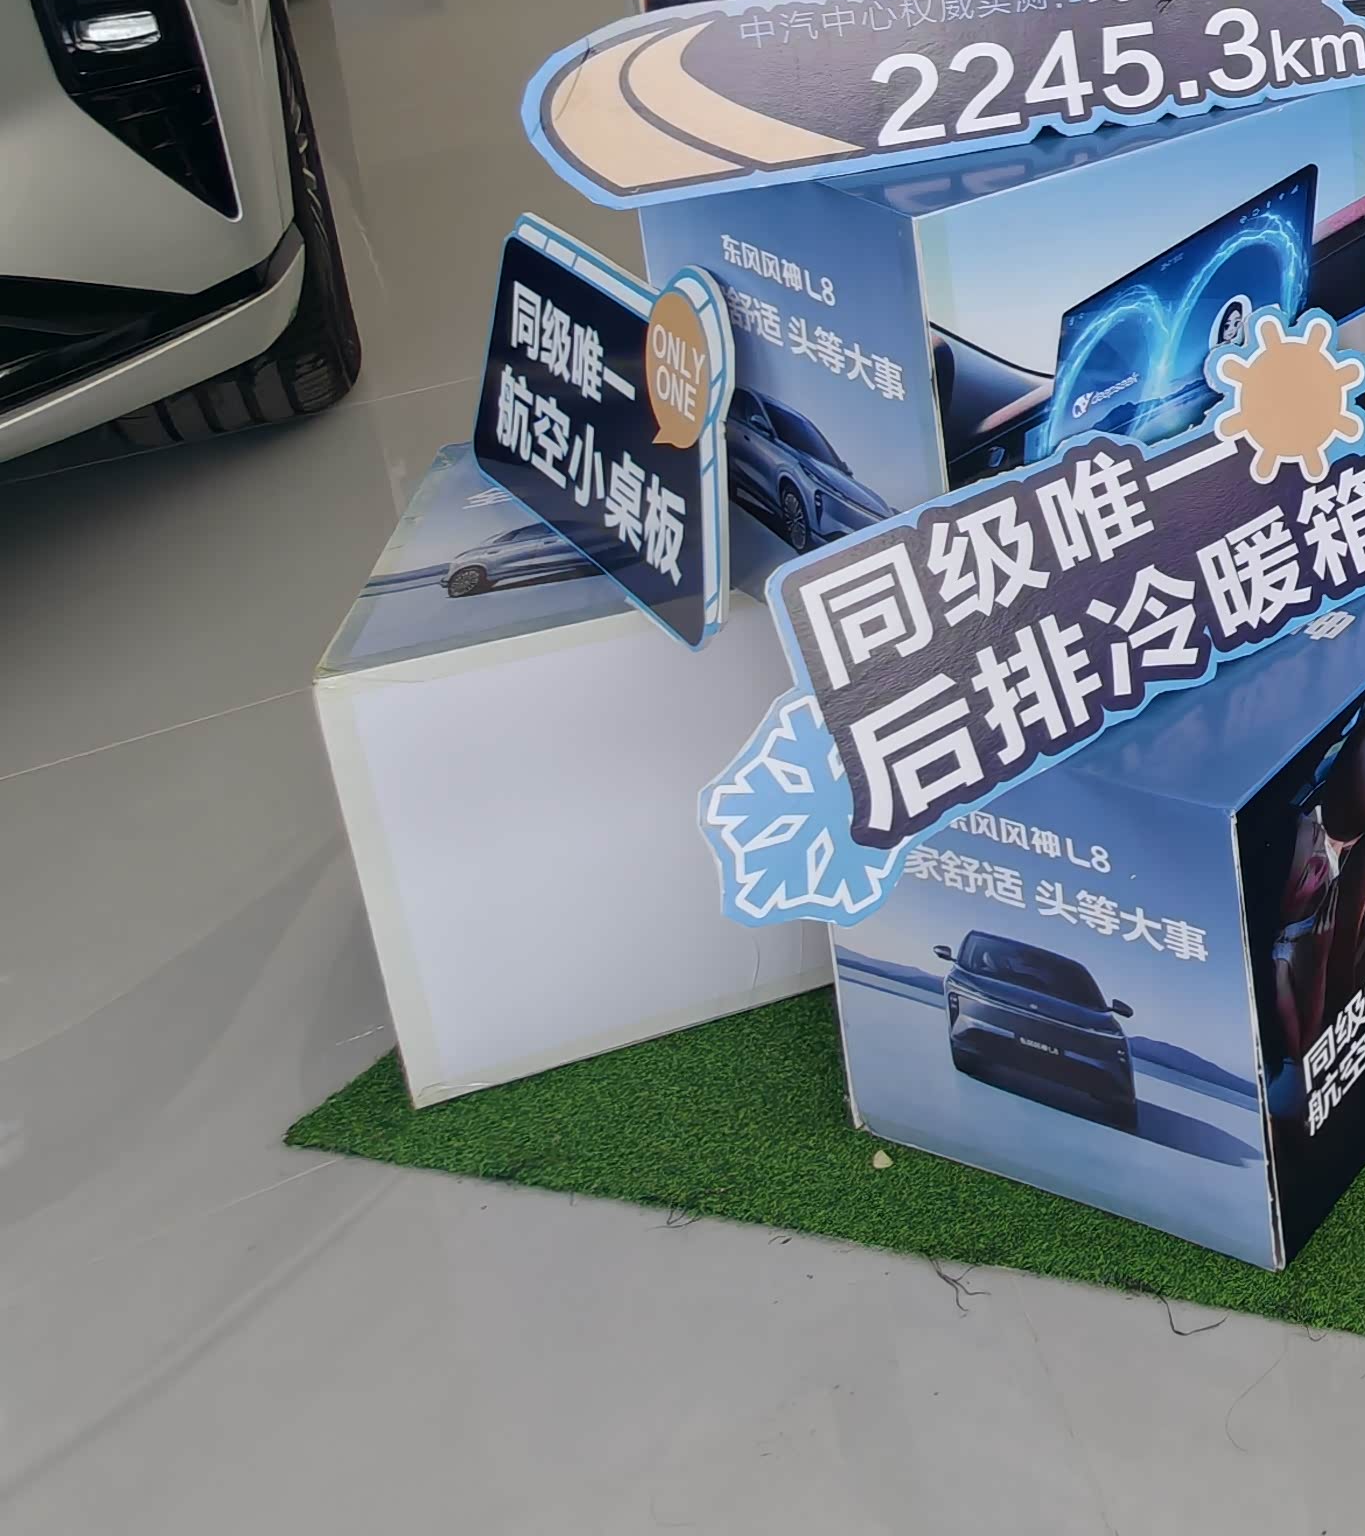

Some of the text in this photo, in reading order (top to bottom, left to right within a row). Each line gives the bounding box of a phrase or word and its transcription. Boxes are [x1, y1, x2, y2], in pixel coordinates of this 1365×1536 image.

[720, 234, 836, 306] 东风风神L8
[510, 279, 635, 403] 同级唯一
[652, 323, 706, 385] ONLY
[656, 364, 696, 422] ONE
[721, 285, 906, 401] 舒适 头等大事
[1090, 371, 1140, 405] deepseek
[497, 365, 687, 587] 航空小桌板
[798, 438, 1240, 690] 同级唯一
[903, 844, 1209, 962] 家舒适 头等大事
